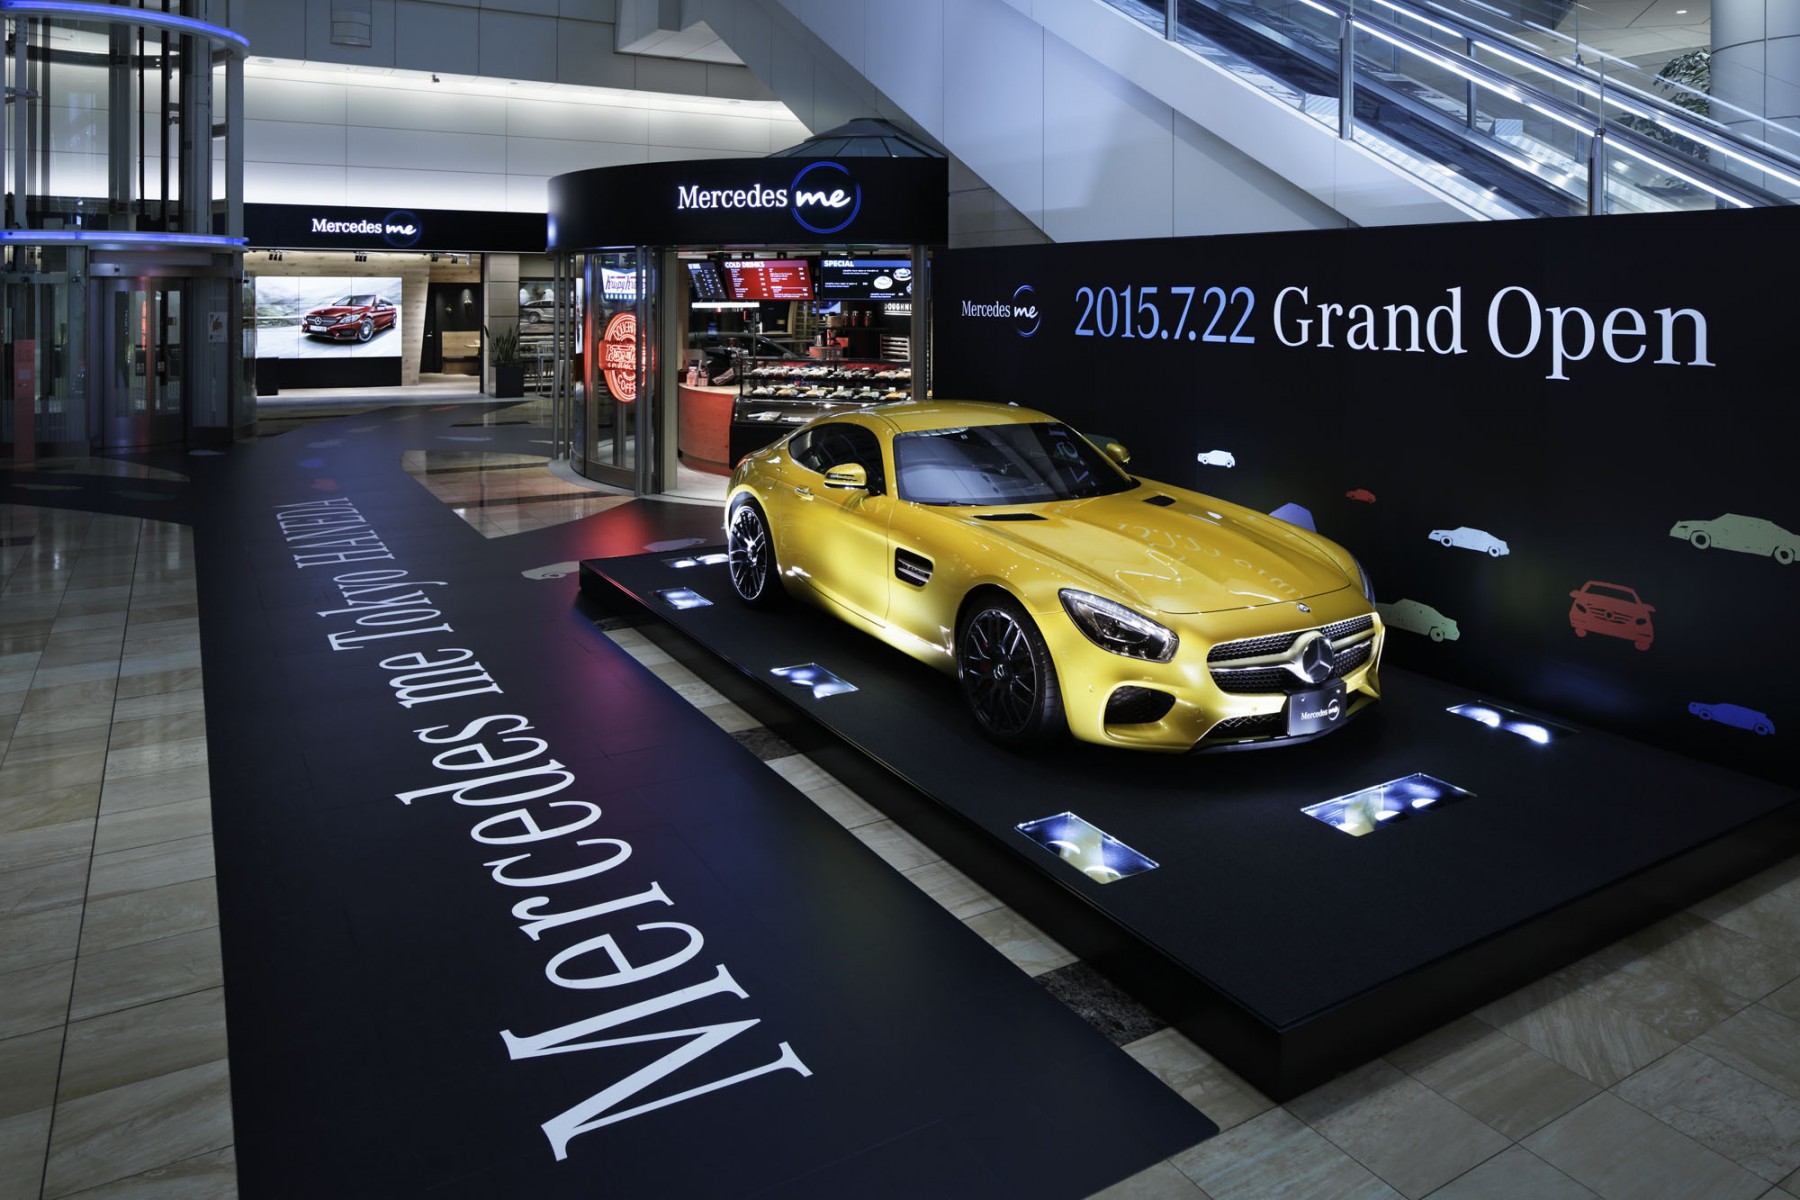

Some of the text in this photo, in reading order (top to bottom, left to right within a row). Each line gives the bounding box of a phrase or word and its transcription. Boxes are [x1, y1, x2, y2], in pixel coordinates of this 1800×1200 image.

[678, 184, 851, 209] Mercedes me
[312, 218, 416, 235] Mercedes me
[823, 260, 854, 268] SPECIAL
[961, 299, 1039, 320] Mercedes me
[1075, 285, 1716, 381] 2015.7.22 Grand Open
[1301, 708, 1328, 720] Mercedes
[272, 497, 813, 1161] Mercedes me Tokyo HANEDA
